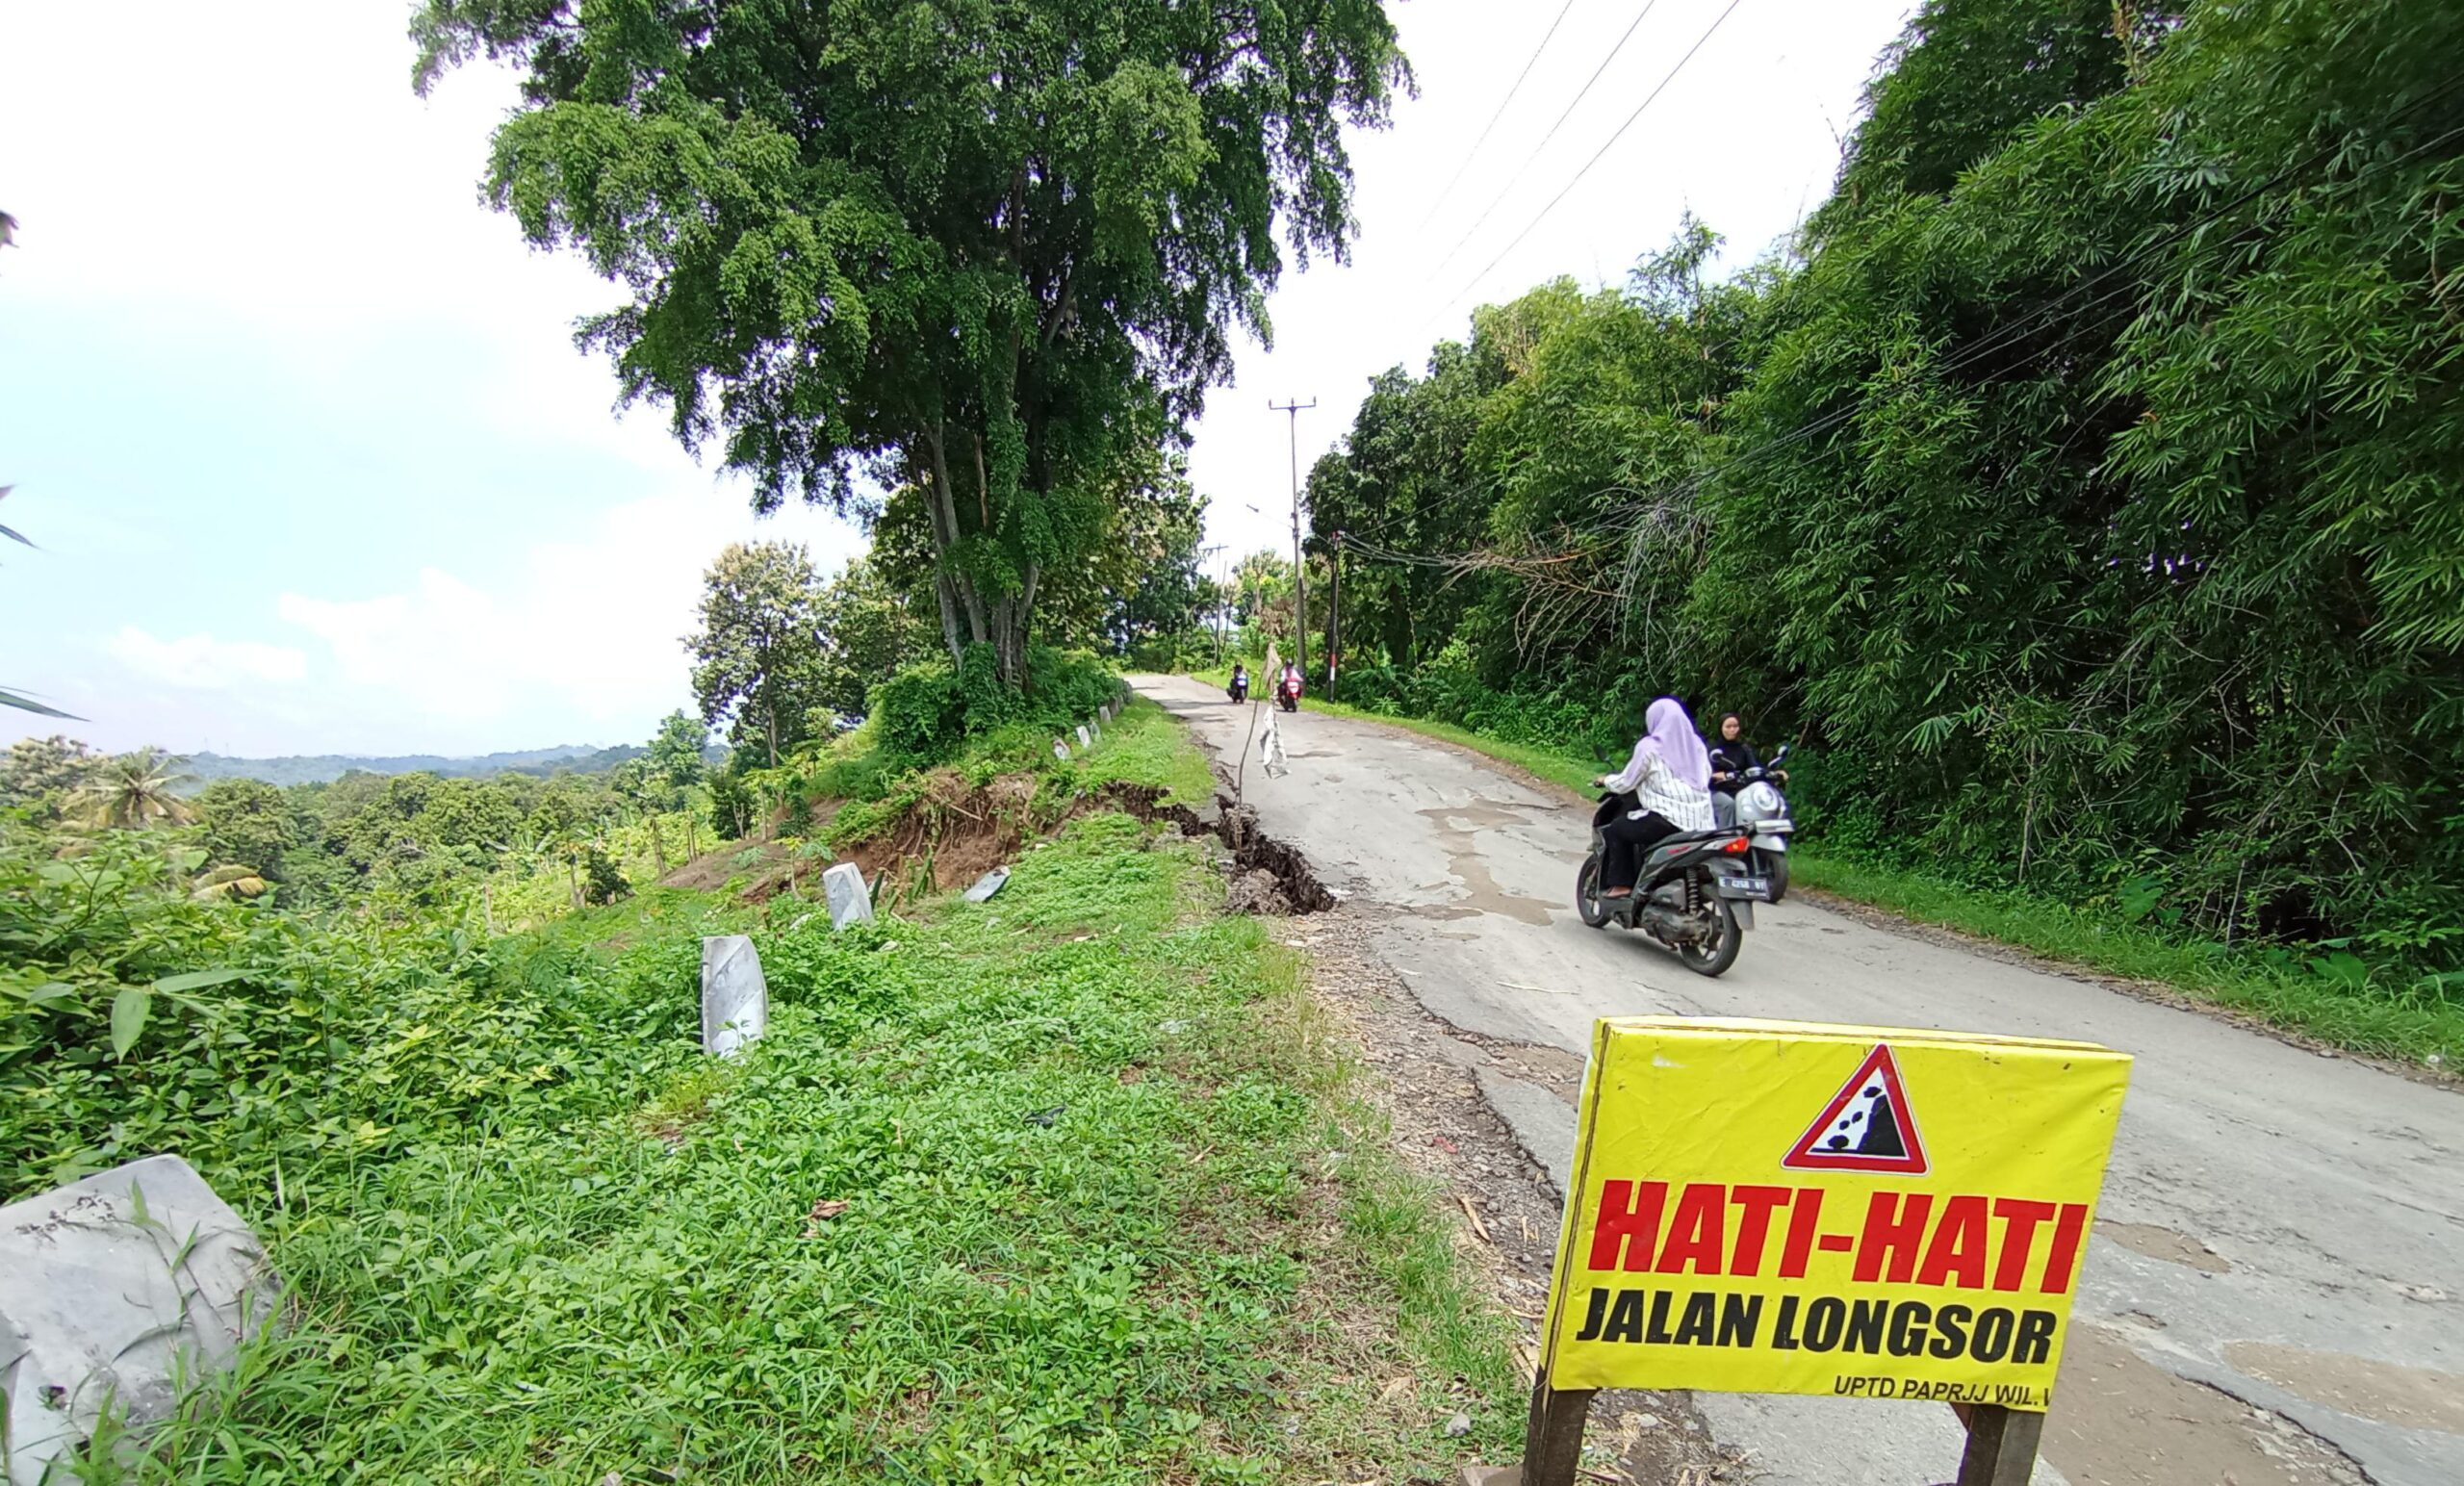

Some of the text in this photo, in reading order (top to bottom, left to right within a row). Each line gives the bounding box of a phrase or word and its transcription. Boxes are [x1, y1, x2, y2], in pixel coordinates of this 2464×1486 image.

[1588, 1180, 2089, 1294] HATI-HATI
[1576, 1288, 2058, 1365] JALAN LONGSOR
[1834, 1375, 1895, 1397] UPTD
[1901, 1379, 1989, 1403] PAPRJJ
